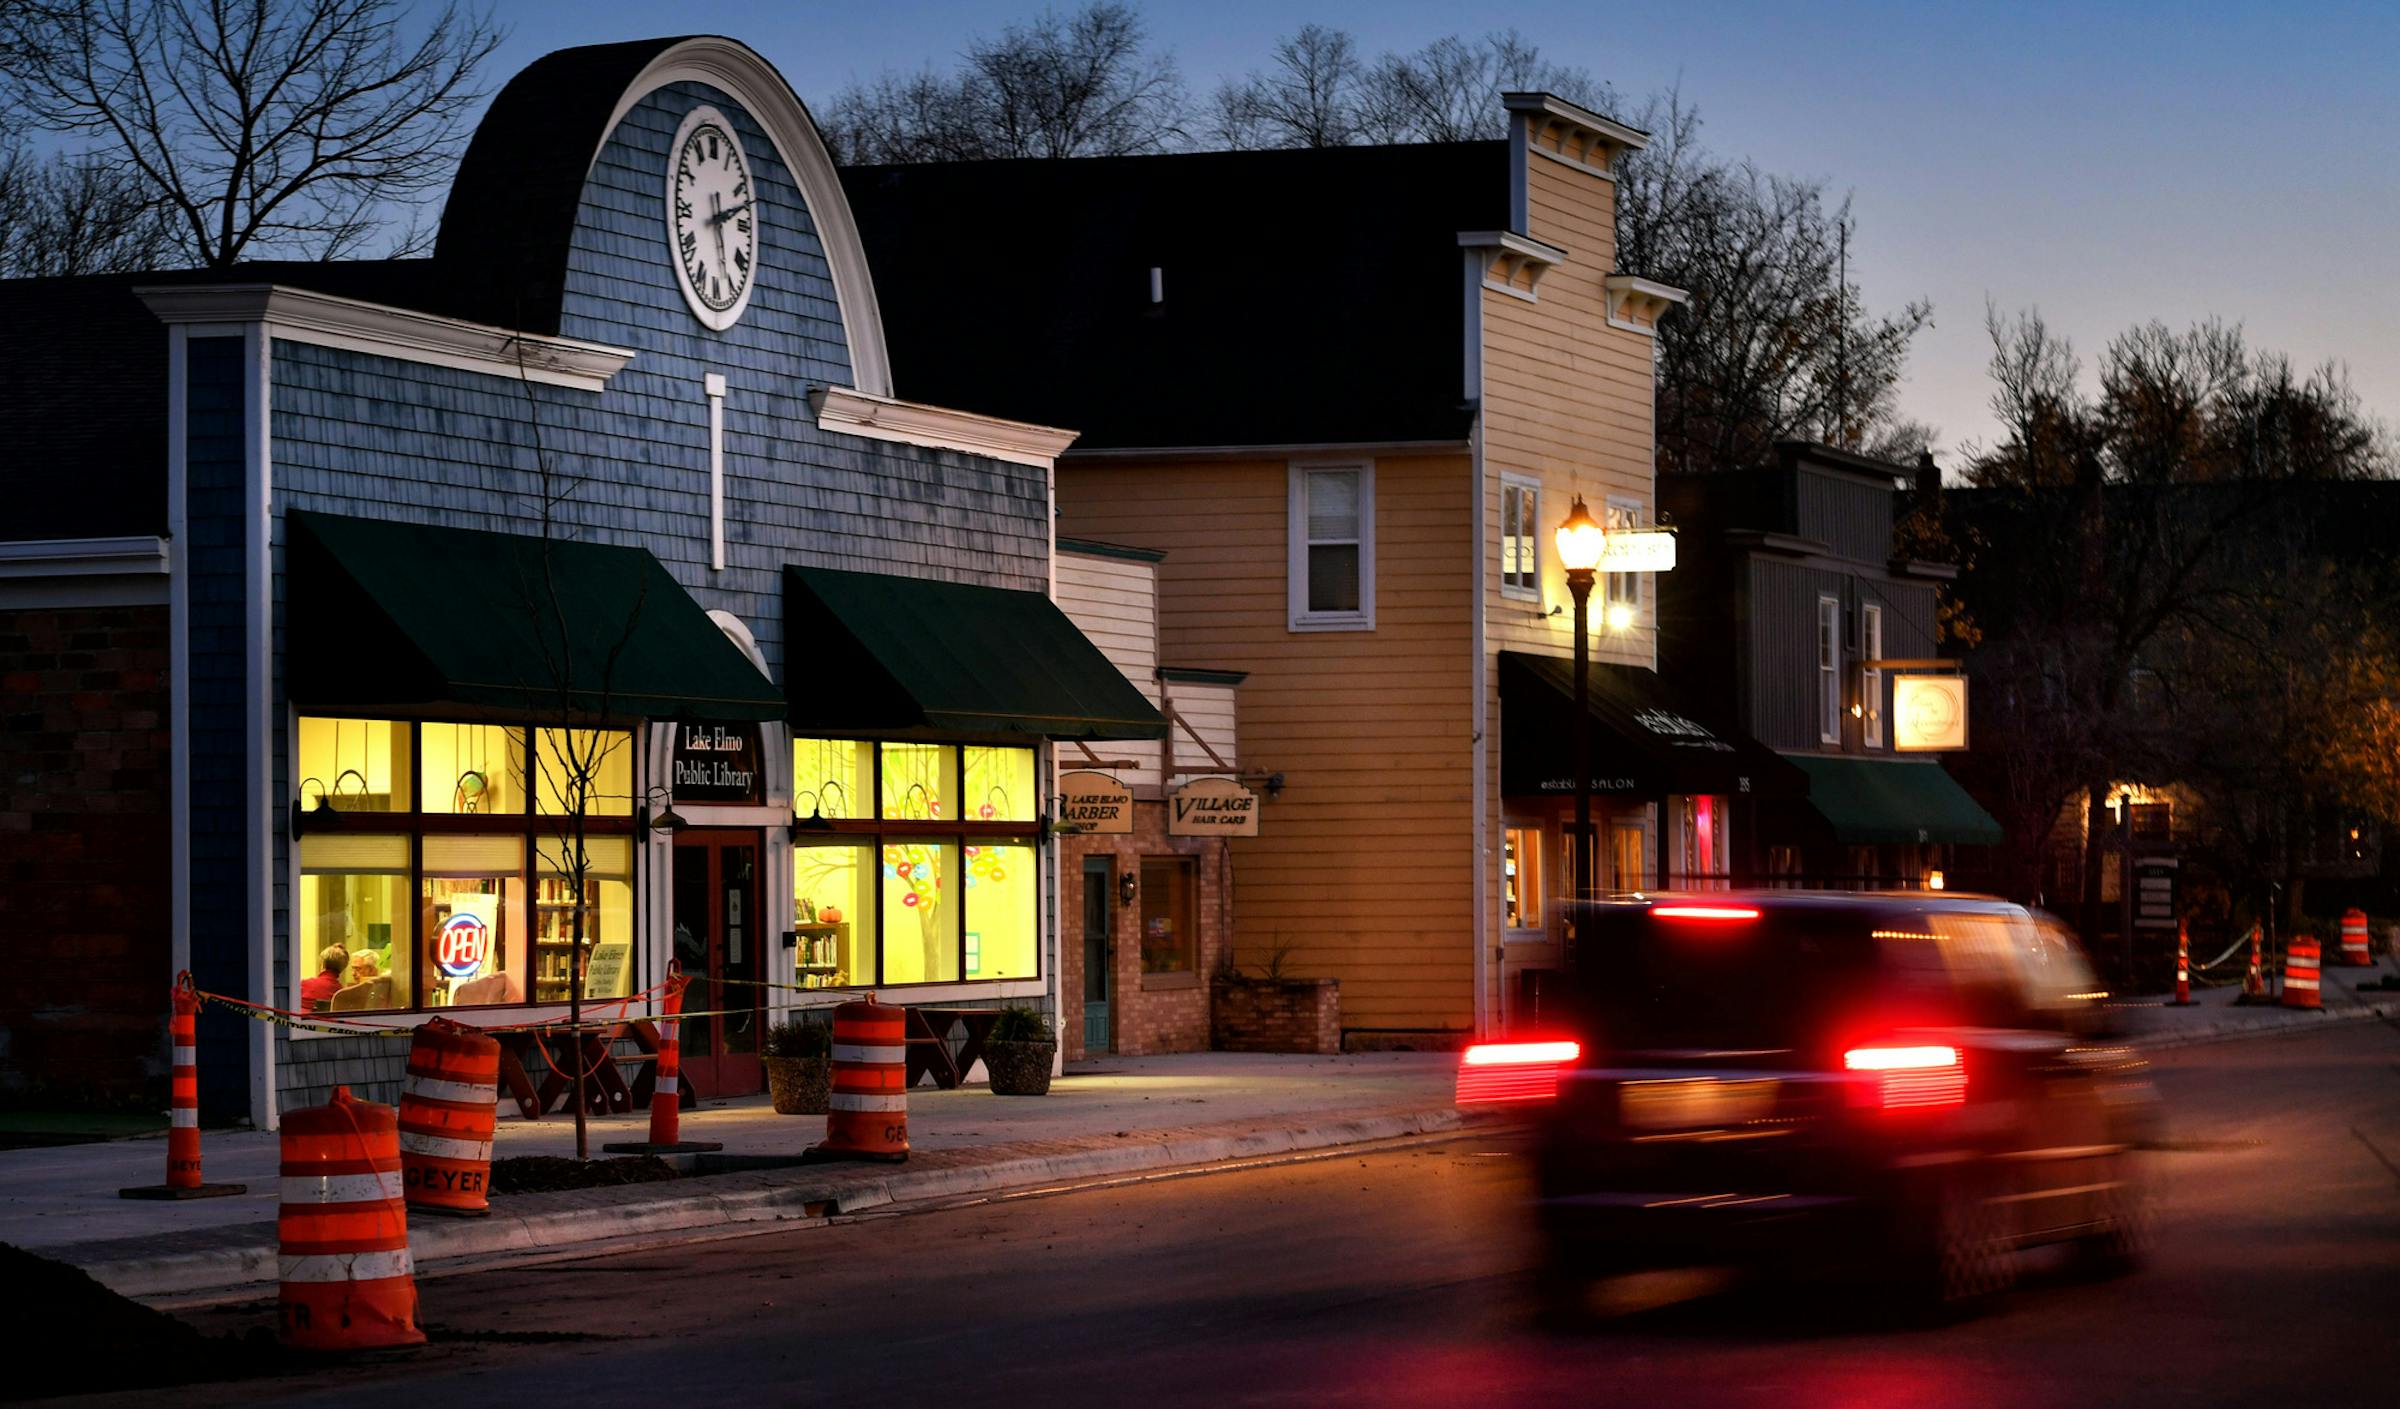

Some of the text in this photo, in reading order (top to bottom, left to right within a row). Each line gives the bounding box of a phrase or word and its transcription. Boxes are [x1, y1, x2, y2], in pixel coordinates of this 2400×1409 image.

[685, 725, 743, 752] Lake Elmo
[675, 760, 754, 795] Public Library
[1071, 795, 1129, 804] LAKE ELMO
[1175, 798, 1253, 822] VILLAGE
[1075, 822, 1098, 831] HOP
[1192, 815, 1217, 824] HAIR
[439, 927, 486, 963] OPEN
[406, 1167, 482, 1192] GEYER
